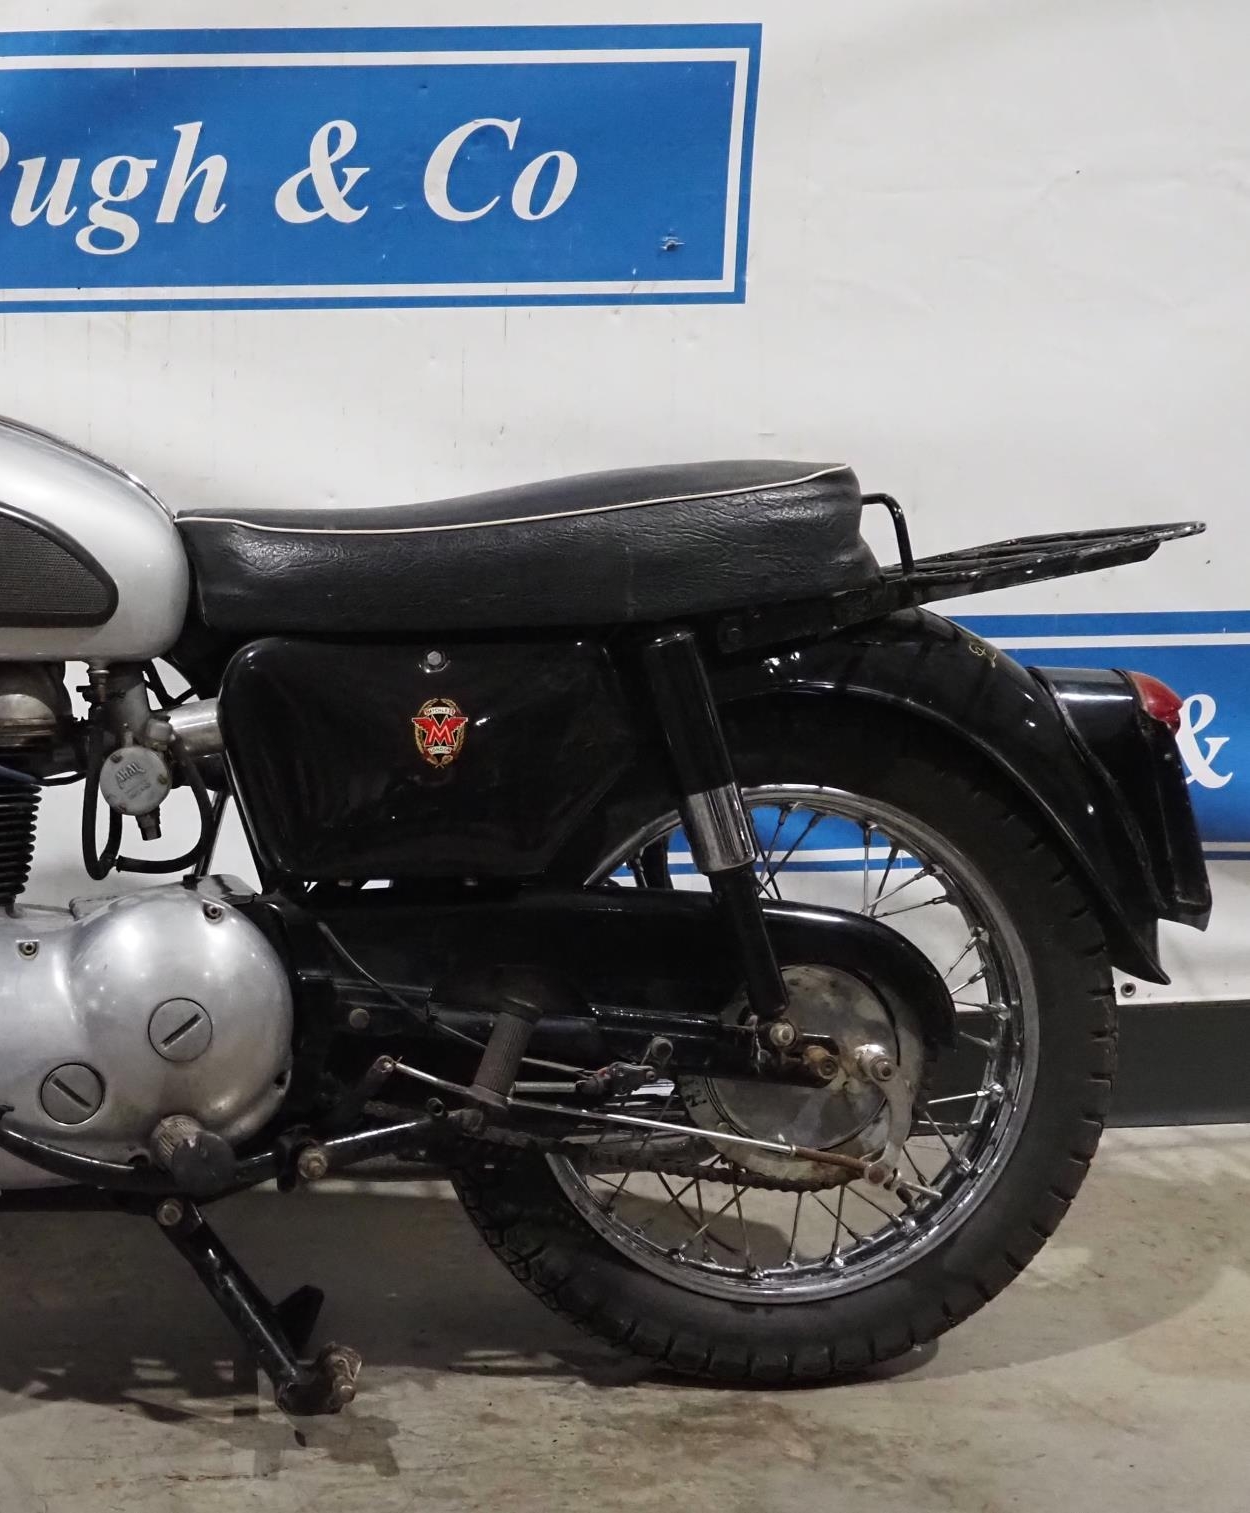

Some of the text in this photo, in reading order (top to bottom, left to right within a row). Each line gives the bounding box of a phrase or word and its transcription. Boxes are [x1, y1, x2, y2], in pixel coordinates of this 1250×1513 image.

[274, 120, 370, 223] &
[422, 118, 578, 222] Co
[423, 714, 456, 747] M
